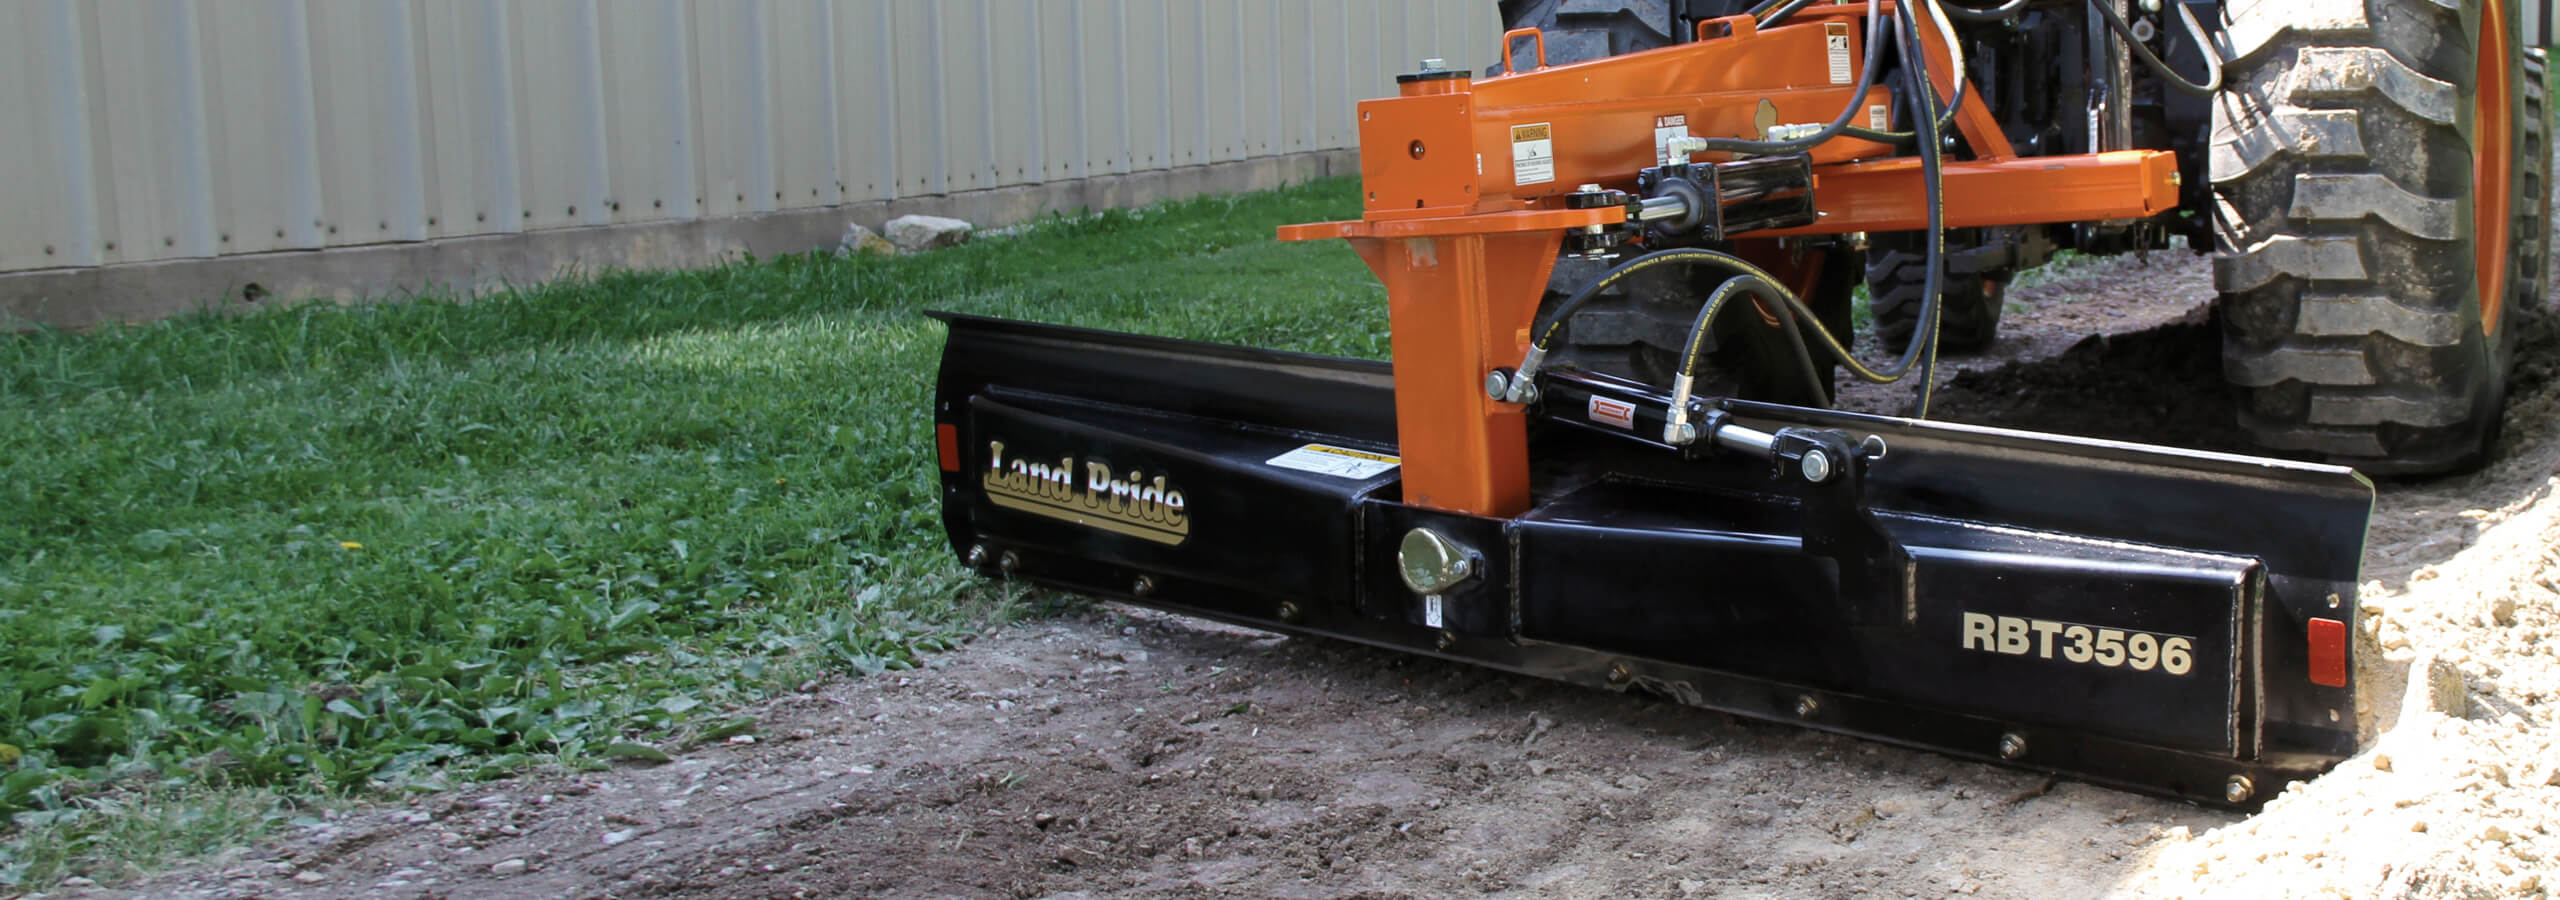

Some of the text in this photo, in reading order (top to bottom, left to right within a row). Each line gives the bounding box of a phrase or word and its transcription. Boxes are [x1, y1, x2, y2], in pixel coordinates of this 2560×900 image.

[988, 441, 1184, 526] Land Pride
[1963, 612, 2193, 675] RBT3596
